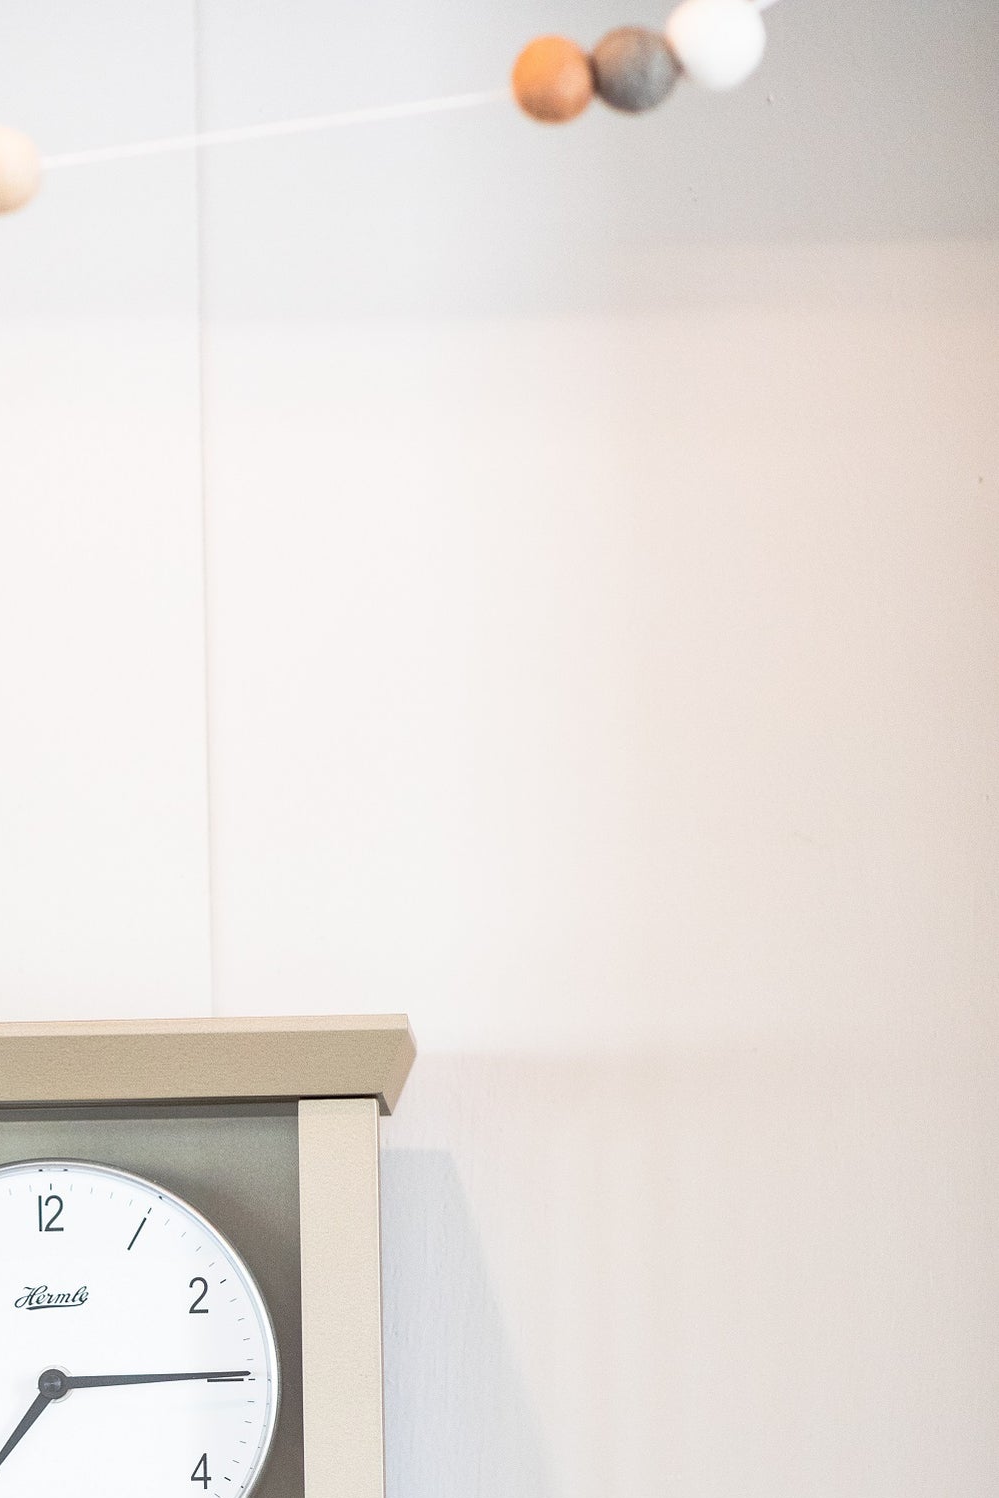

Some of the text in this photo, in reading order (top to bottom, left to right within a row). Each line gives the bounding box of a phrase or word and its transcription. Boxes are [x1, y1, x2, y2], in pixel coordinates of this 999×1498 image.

[38, 1194, 65, 1233] 12
[14, 1284, 89, 1311] Hermle
[188, 1276, 210, 1315] 2
[189, 1453, 213, 1490] 4
